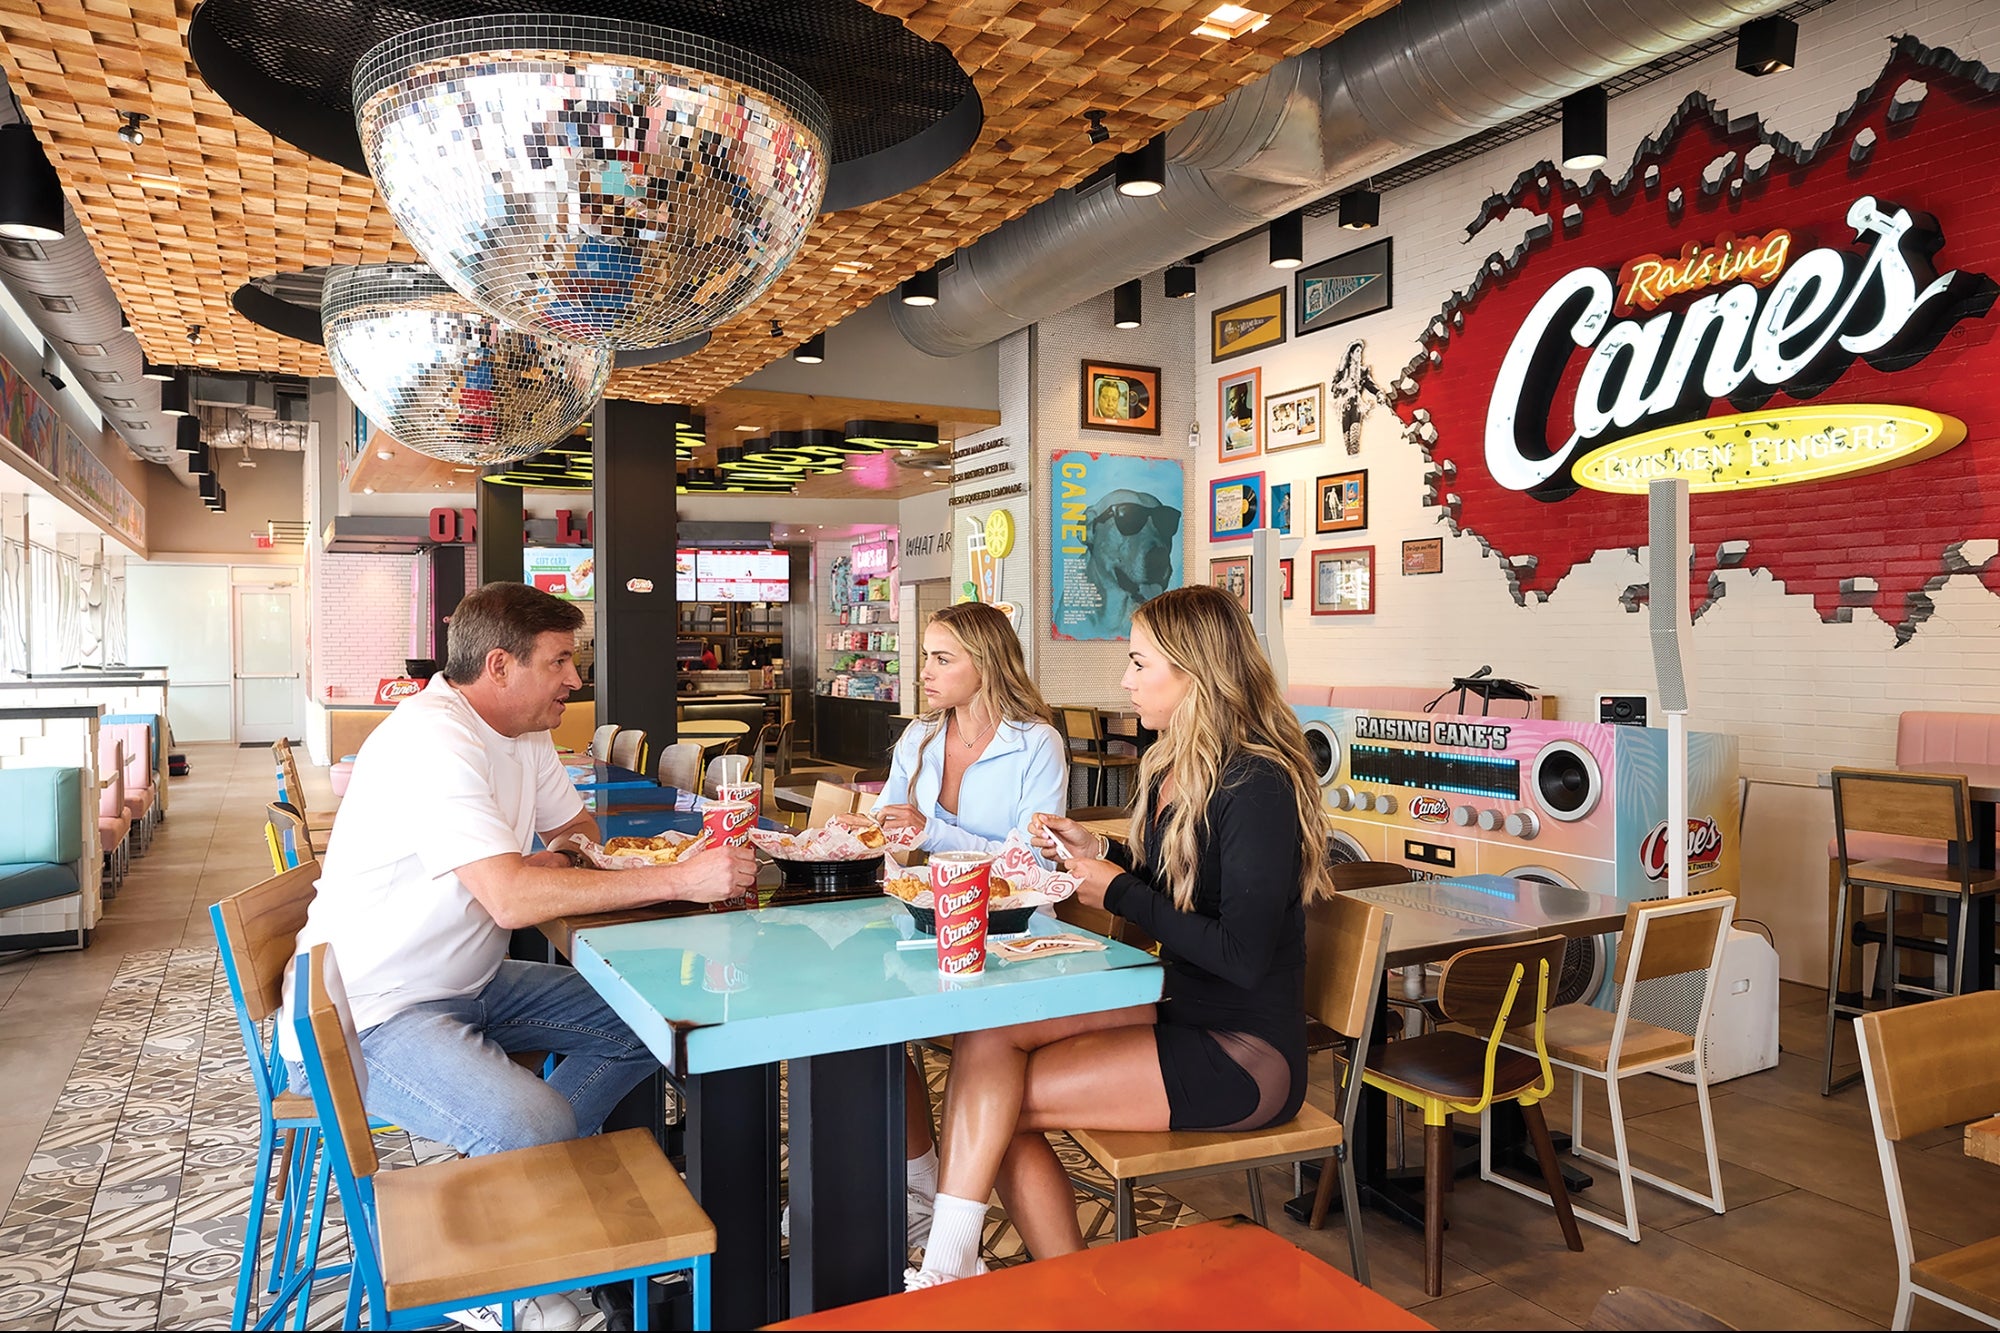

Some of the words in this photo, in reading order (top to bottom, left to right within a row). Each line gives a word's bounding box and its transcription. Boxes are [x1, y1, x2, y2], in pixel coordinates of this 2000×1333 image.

[1625, 234, 1791, 306] Raising
[999, 462, 1009, 472] TEA
[1604, 444, 1734, 482] CHICKEN
[1750, 422, 1898, 467] FINGERS
[905, 534, 934, 557] WHAT
[1356, 716, 1431, 744] RAISING
[1434, 722, 1509, 750] CANE'S
[1410, 796, 1448, 818] Cane's
[1644, 818, 1720, 877] Ce's
[939, 885, 982, 918] Cane's
[940, 916, 982, 949] Cane's
